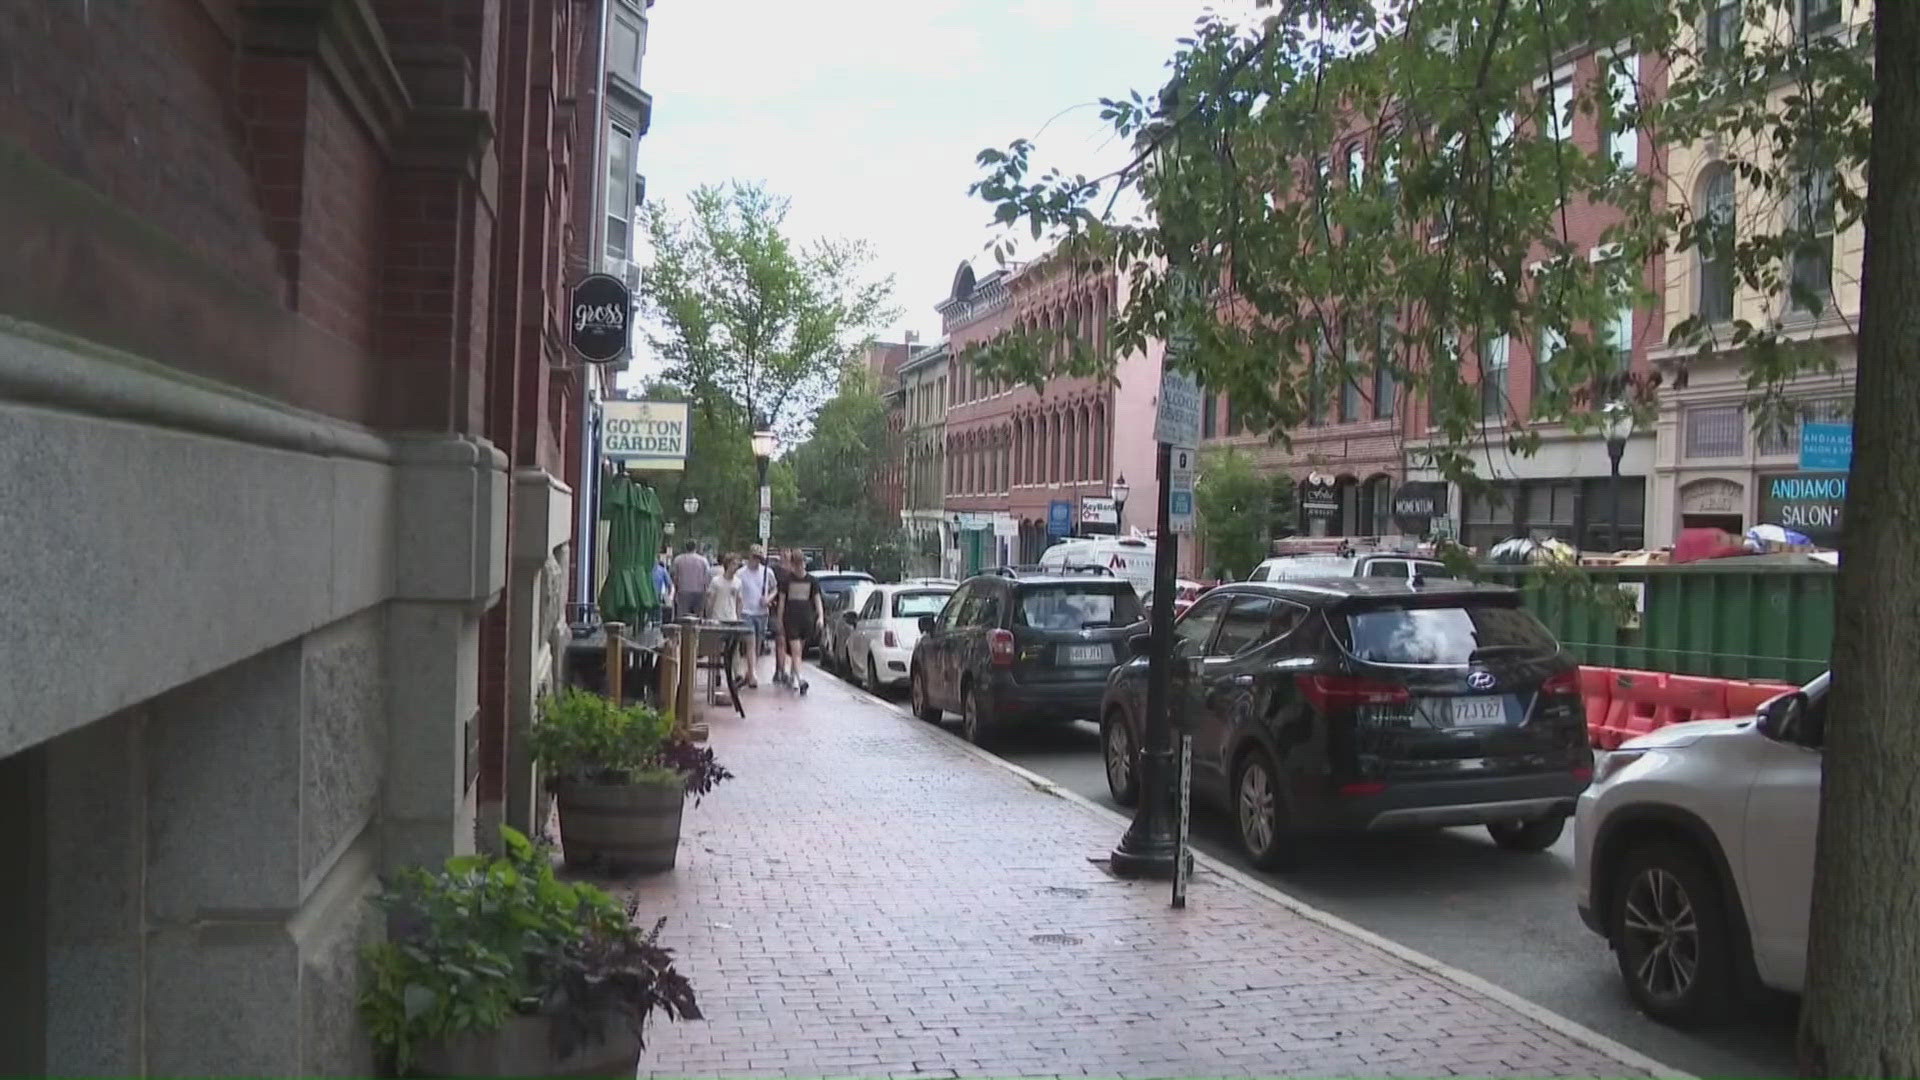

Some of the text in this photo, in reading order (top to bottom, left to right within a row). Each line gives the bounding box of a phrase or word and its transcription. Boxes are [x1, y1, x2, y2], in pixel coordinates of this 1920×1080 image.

[575, 303, 623, 331] gross
[606, 435, 681, 452] GARDEN
[1396, 499, 1434, 514] MOMENTUM
[1782, 505, 1832, 526] SALON
